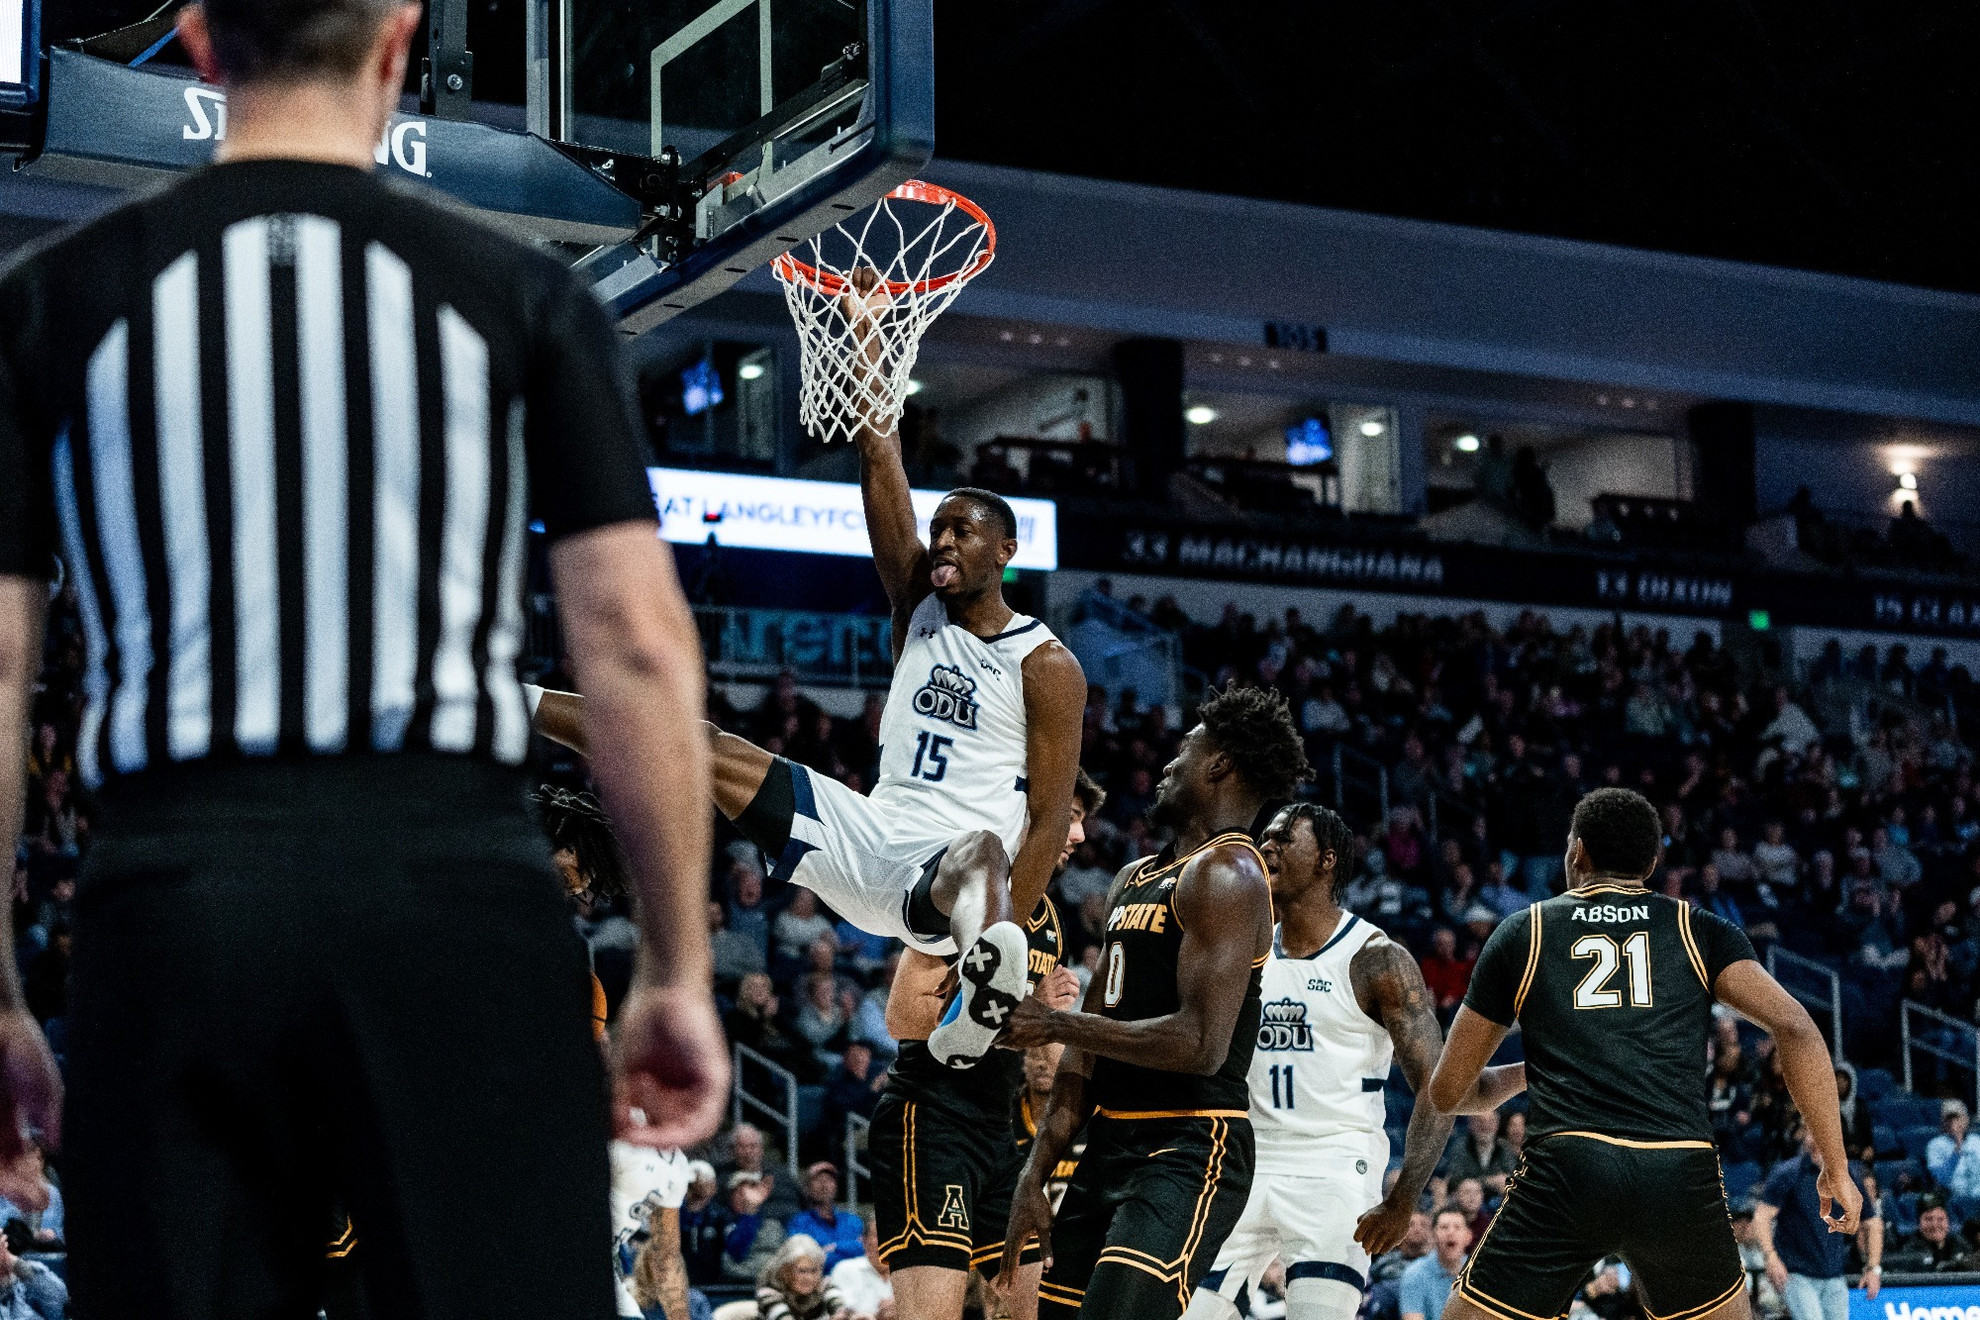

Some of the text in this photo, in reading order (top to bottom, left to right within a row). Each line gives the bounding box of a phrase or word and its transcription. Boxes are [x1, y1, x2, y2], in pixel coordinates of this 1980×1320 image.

[912, 686, 980, 731] ODU
[911, 730, 954, 782] 15
[1571, 904, 1650, 923] ABSON
[1104, 941, 1126, 1008] 0
[1570, 931, 1653, 1010] 21
[1256, 1023, 1314, 1052] ODU
[1269, 1064, 1295, 1109] 11
[938, 1184, 969, 1230] A
